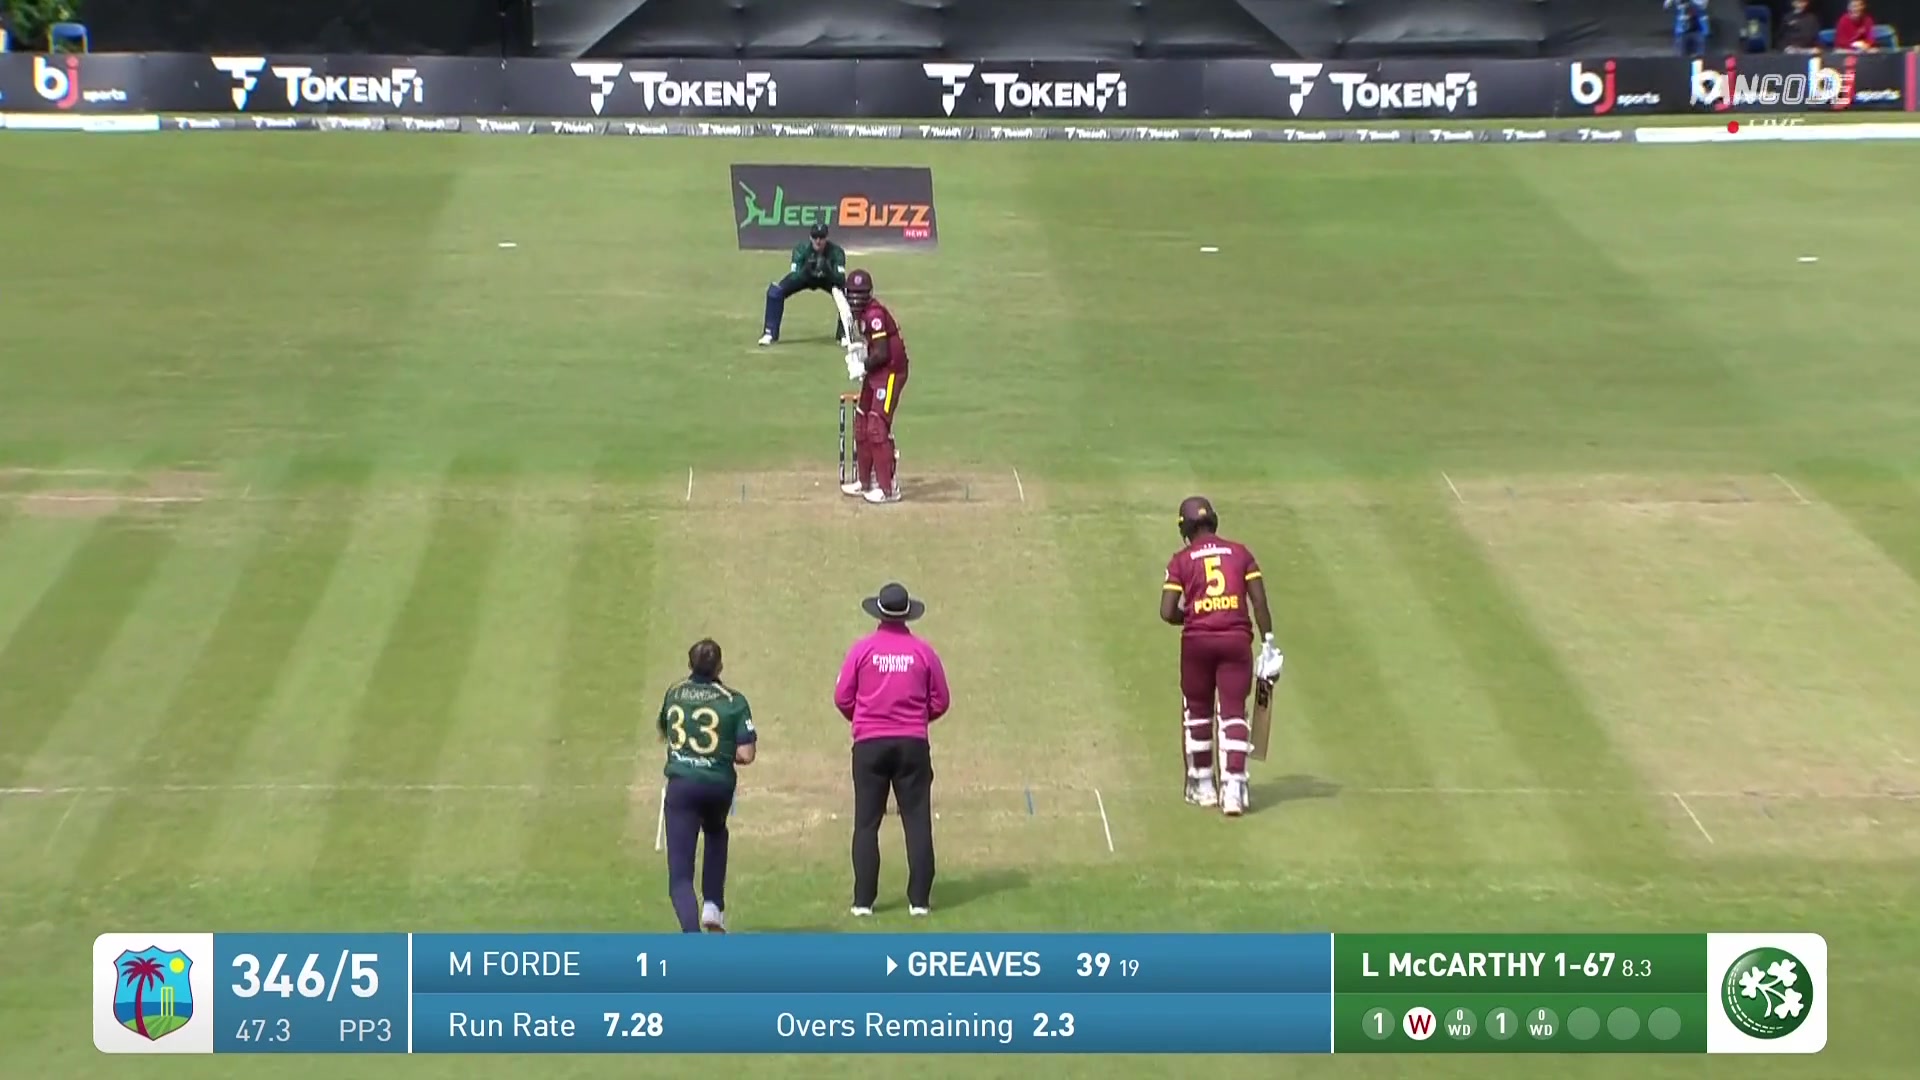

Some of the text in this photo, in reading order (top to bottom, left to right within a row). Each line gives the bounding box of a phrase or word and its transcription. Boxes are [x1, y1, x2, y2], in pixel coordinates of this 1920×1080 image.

[1203, 555, 1226, 597] 5
[1193, 595, 1239, 614] FORDE
[666, 704, 720, 755] 33
